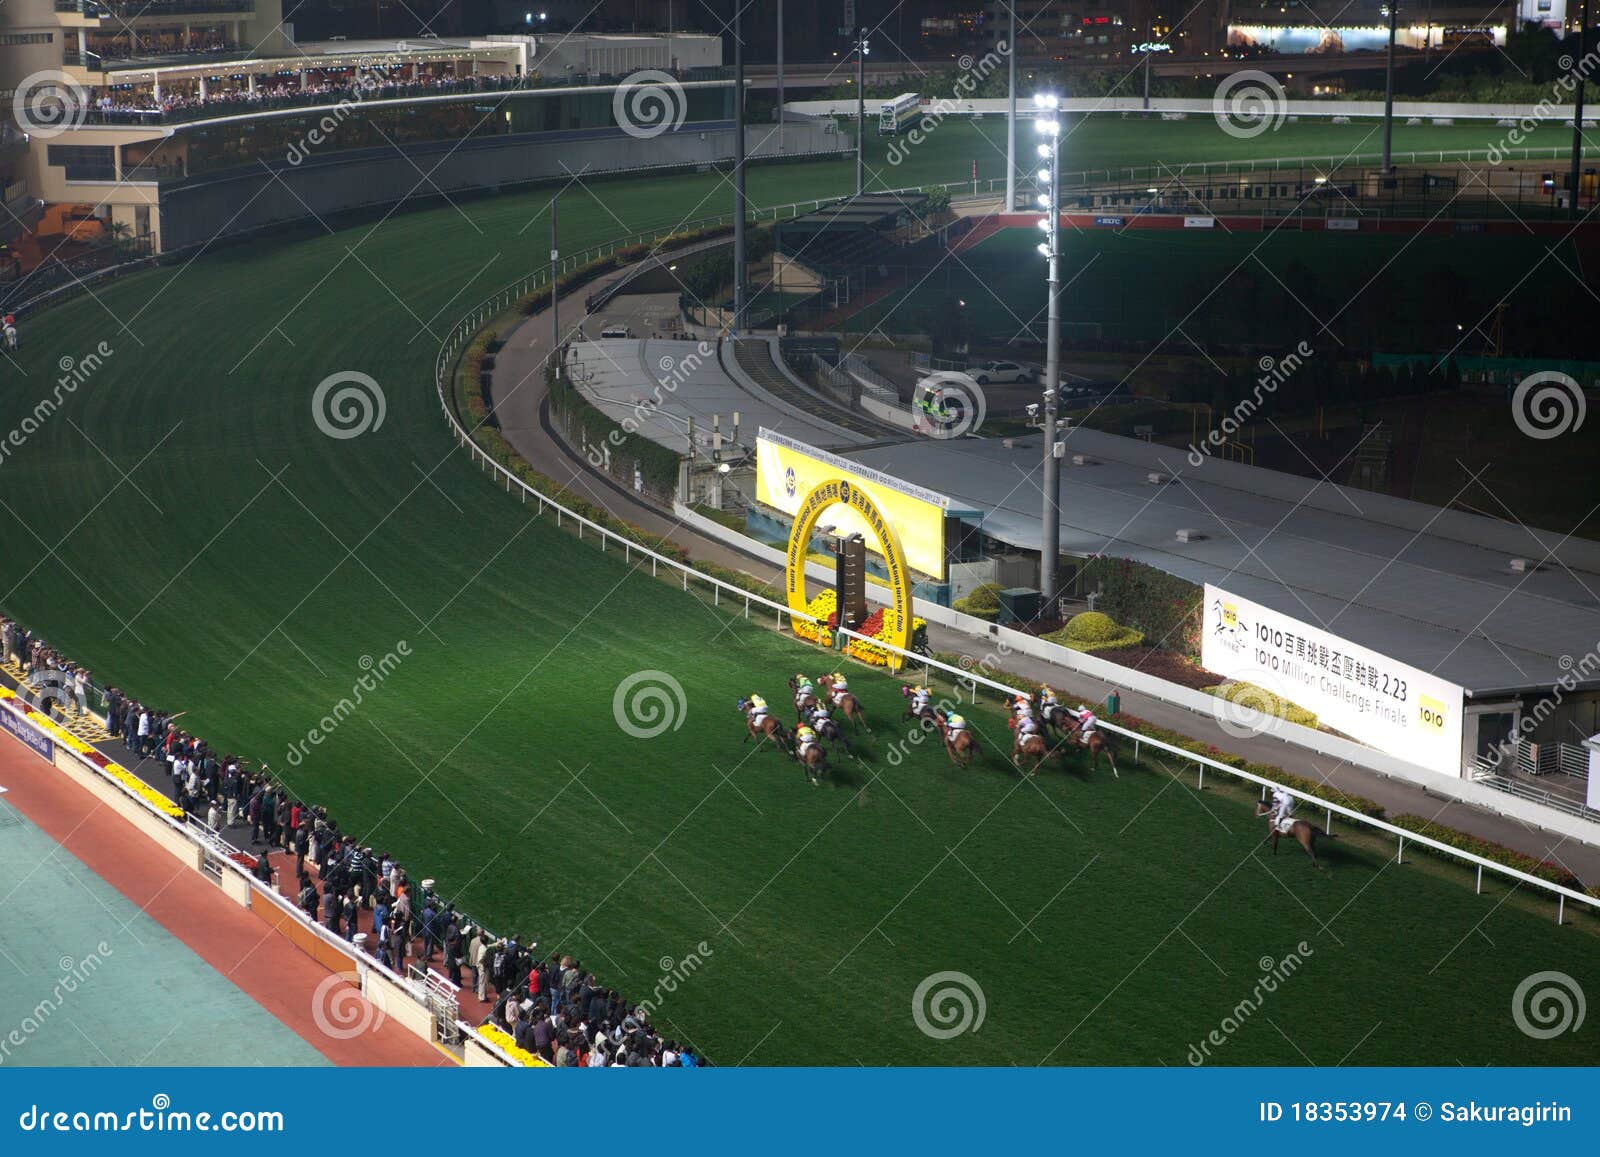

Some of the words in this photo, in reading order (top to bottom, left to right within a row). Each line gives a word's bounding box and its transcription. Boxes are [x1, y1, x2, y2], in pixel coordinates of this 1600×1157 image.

[1255, 647, 1279, 671] 1010
[1282, 659, 1317, 689] Million
[1320, 675, 1371, 713] Challenge
[1375, 699, 1408, 728] Finale
[1383, 674, 1408, 703] 2.23
[1419, 706, 1443, 728] 1010
